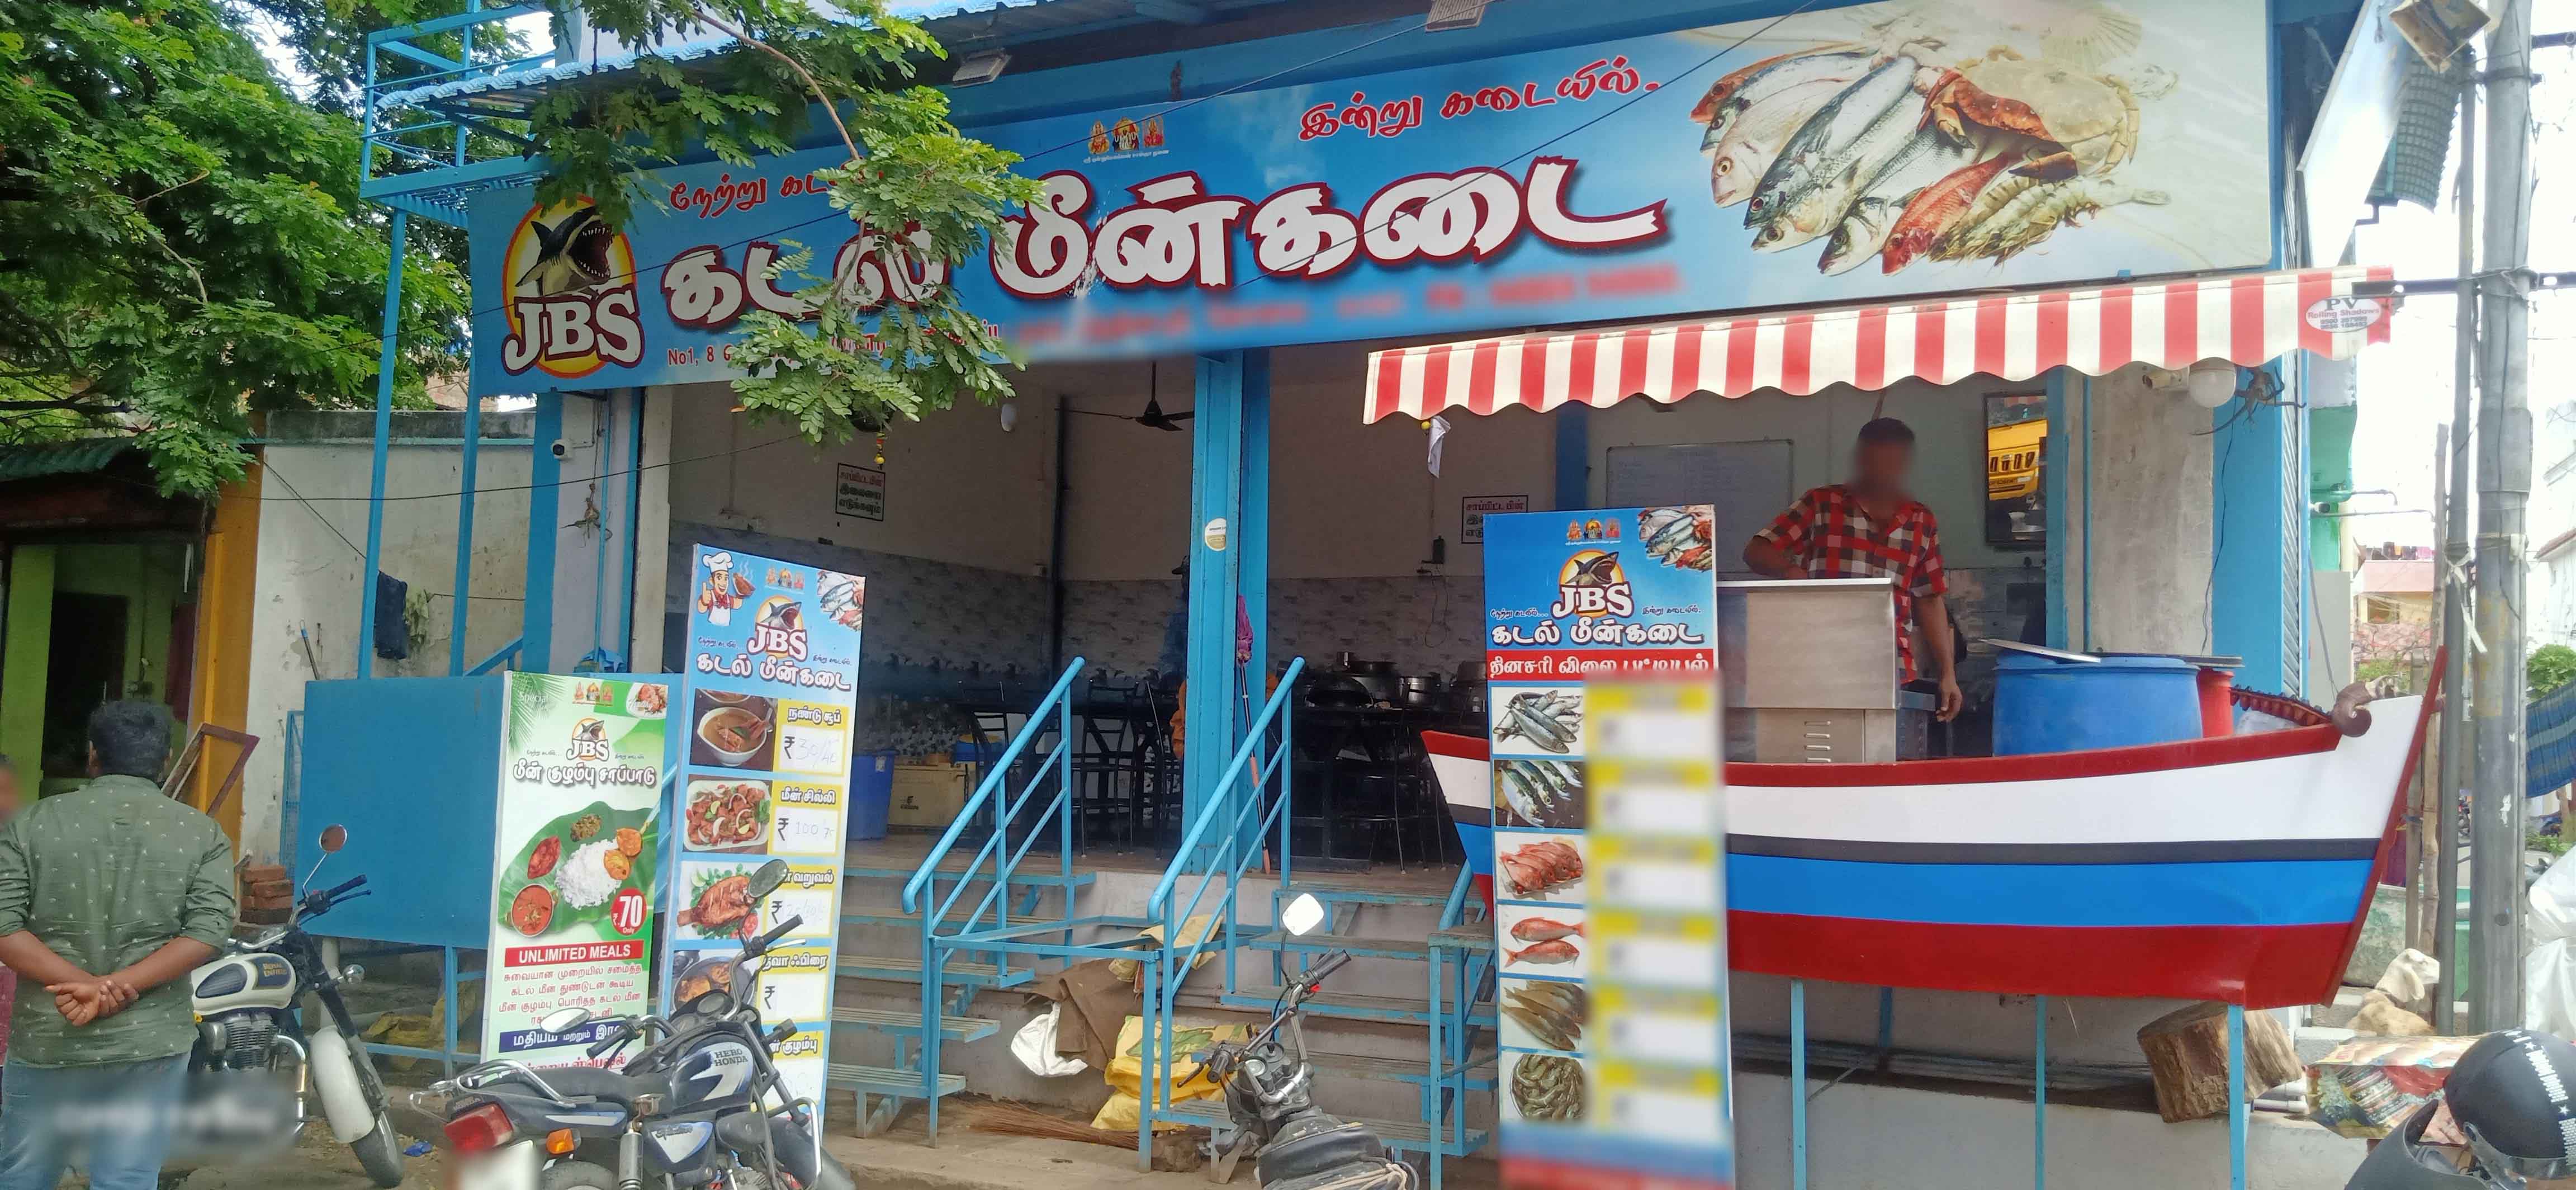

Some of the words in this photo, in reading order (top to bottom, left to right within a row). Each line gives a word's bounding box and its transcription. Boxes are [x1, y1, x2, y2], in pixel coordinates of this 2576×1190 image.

[1298, 91, 1423, 143] இன்று
[671, 173, 766, 219] நேற்று
[2324, 298, 2359, 311] PV
[503, 286, 646, 376] JBS
[667, 346, 699, 367] No1,
[707, 345, 715, 363] 8
[1552, 581, 1635, 620] JBS
[1642, 605, 1664, 616] இன்று
[747, 623, 808, 662] JBS
[1491, 620, 1562, 646] கடல்
[697, 653, 754, 678] கடல்
[1489, 655, 1554, 679] தினசரி
[787, 706, 822, 724] நண்டு
[566, 738, 610, 762] JBS
[513, 757, 544, 782] மீன்
[547, 762, 595, 787] குழம்பு
[599, 764, 656, 786] சாப்பாடு
[780, 786, 803, 803] மீன்
[803, 787, 836, 804] சில்லி
[794, 869, 835, 889] வறுவல்
[619, 895, 643, 928] 70
[518, 947, 587, 964] UNLIMITED
[589, 944, 631, 960] MEALS
[714, 1048, 743, 1059] HERO
[783, 1035, 818, 1056] குழம்பு
[713, 1055, 749, 1066] HONDA
